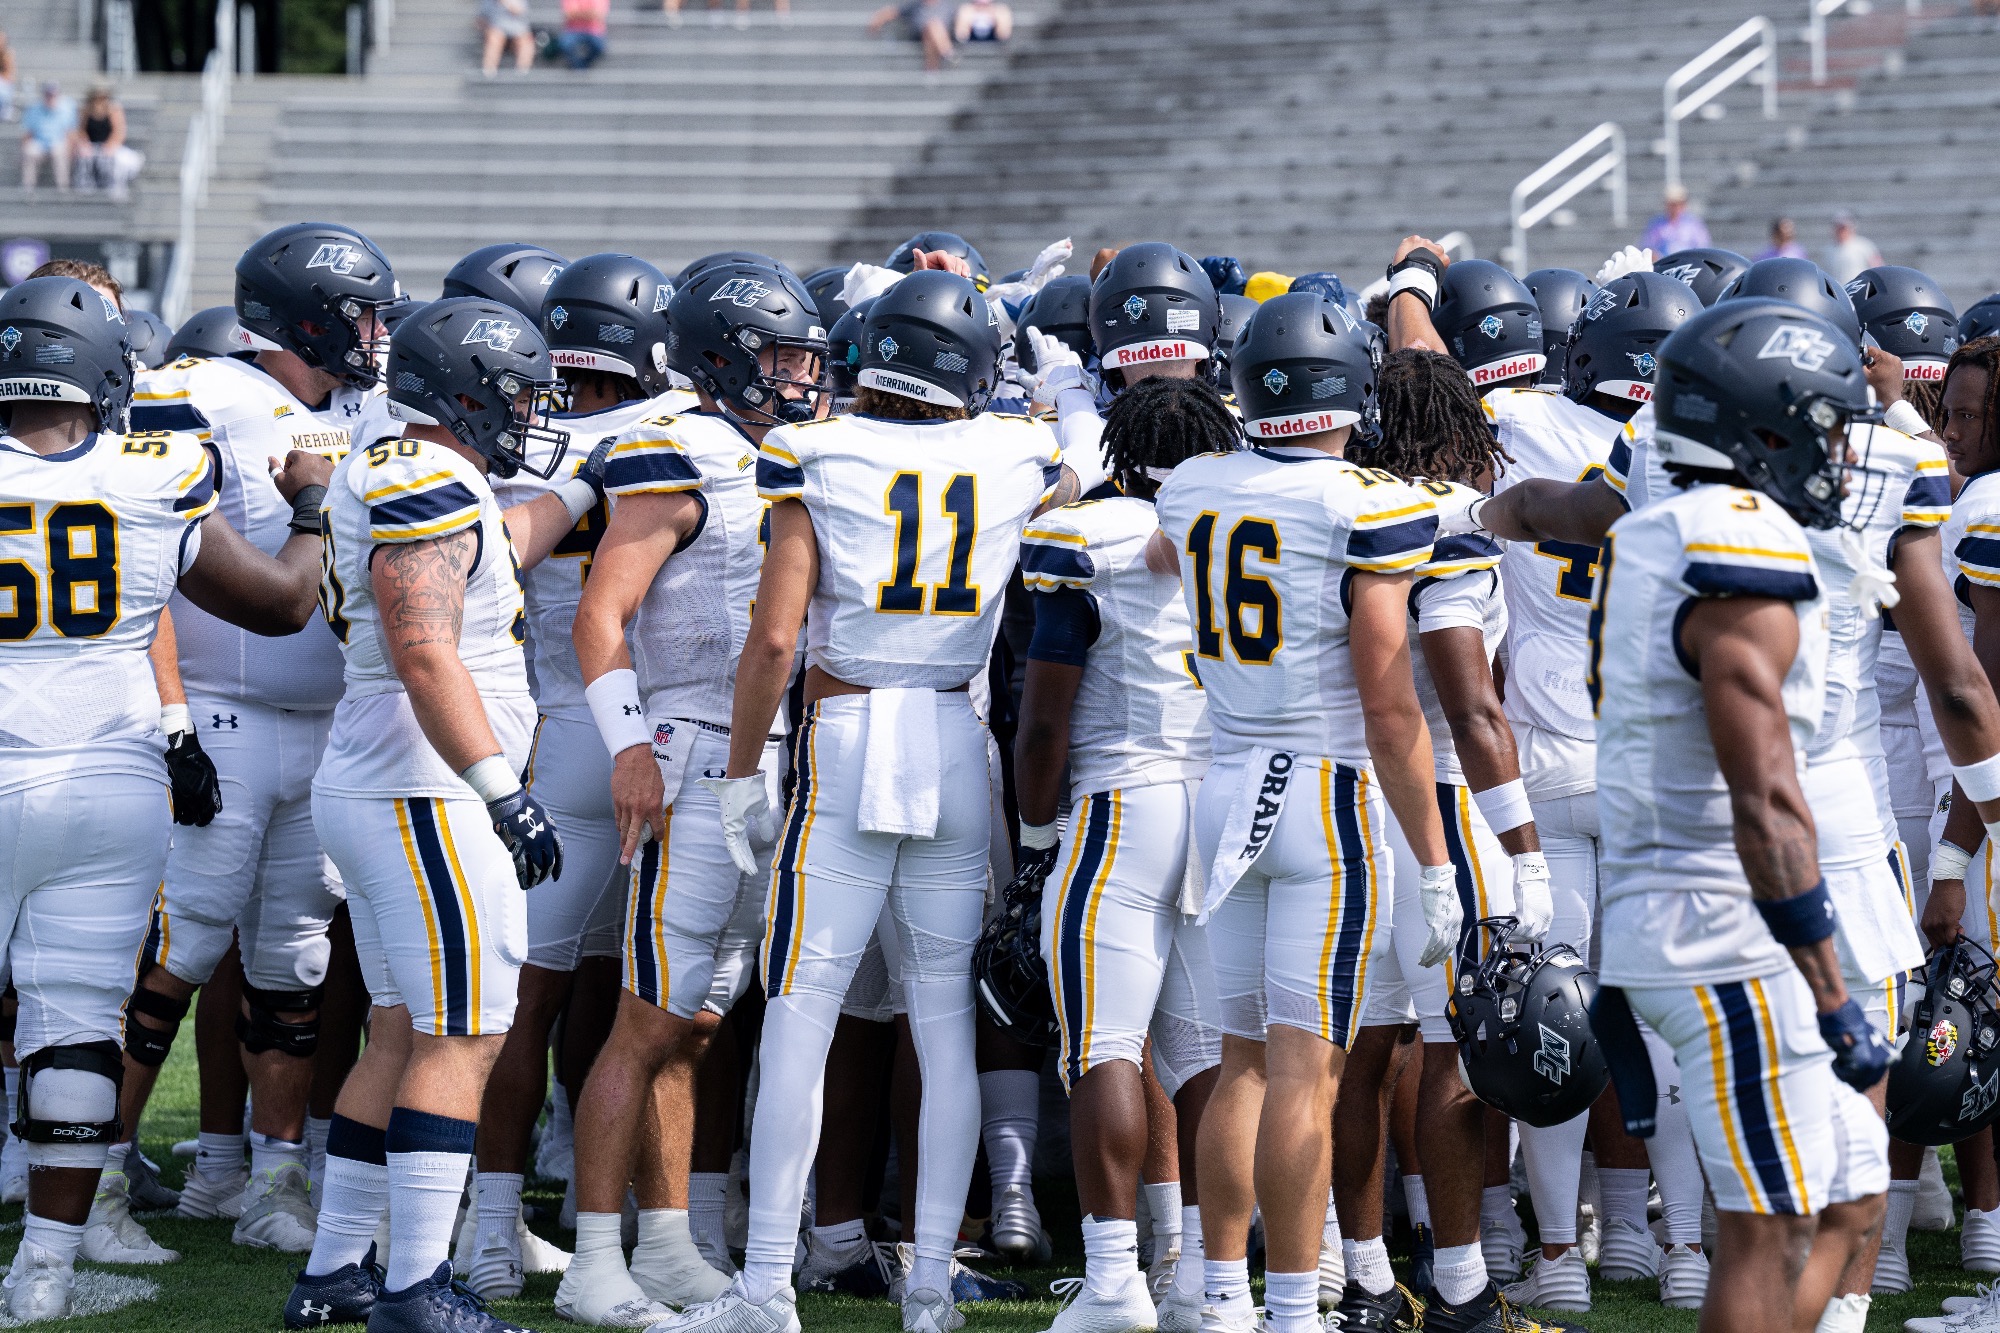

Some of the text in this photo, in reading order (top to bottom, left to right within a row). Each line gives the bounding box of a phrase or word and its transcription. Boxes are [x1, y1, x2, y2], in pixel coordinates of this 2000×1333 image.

[306, 244, 363, 275] MC
[460, 319, 521, 351] MC
[1118, 343, 1187, 364] Riddell
[1474, 357, 1537, 383] Riddell
[1904, 365, 1946, 380] iddel
[875, 374, 928, 398] MERRIMACK
[1259, 414, 1333, 436] Riddell
[366, 438, 421, 469] 50
[875, 470, 982, 617] 11
[1186, 509, 1284, 667] 16
[1238, 752, 1294, 862] ORADE
